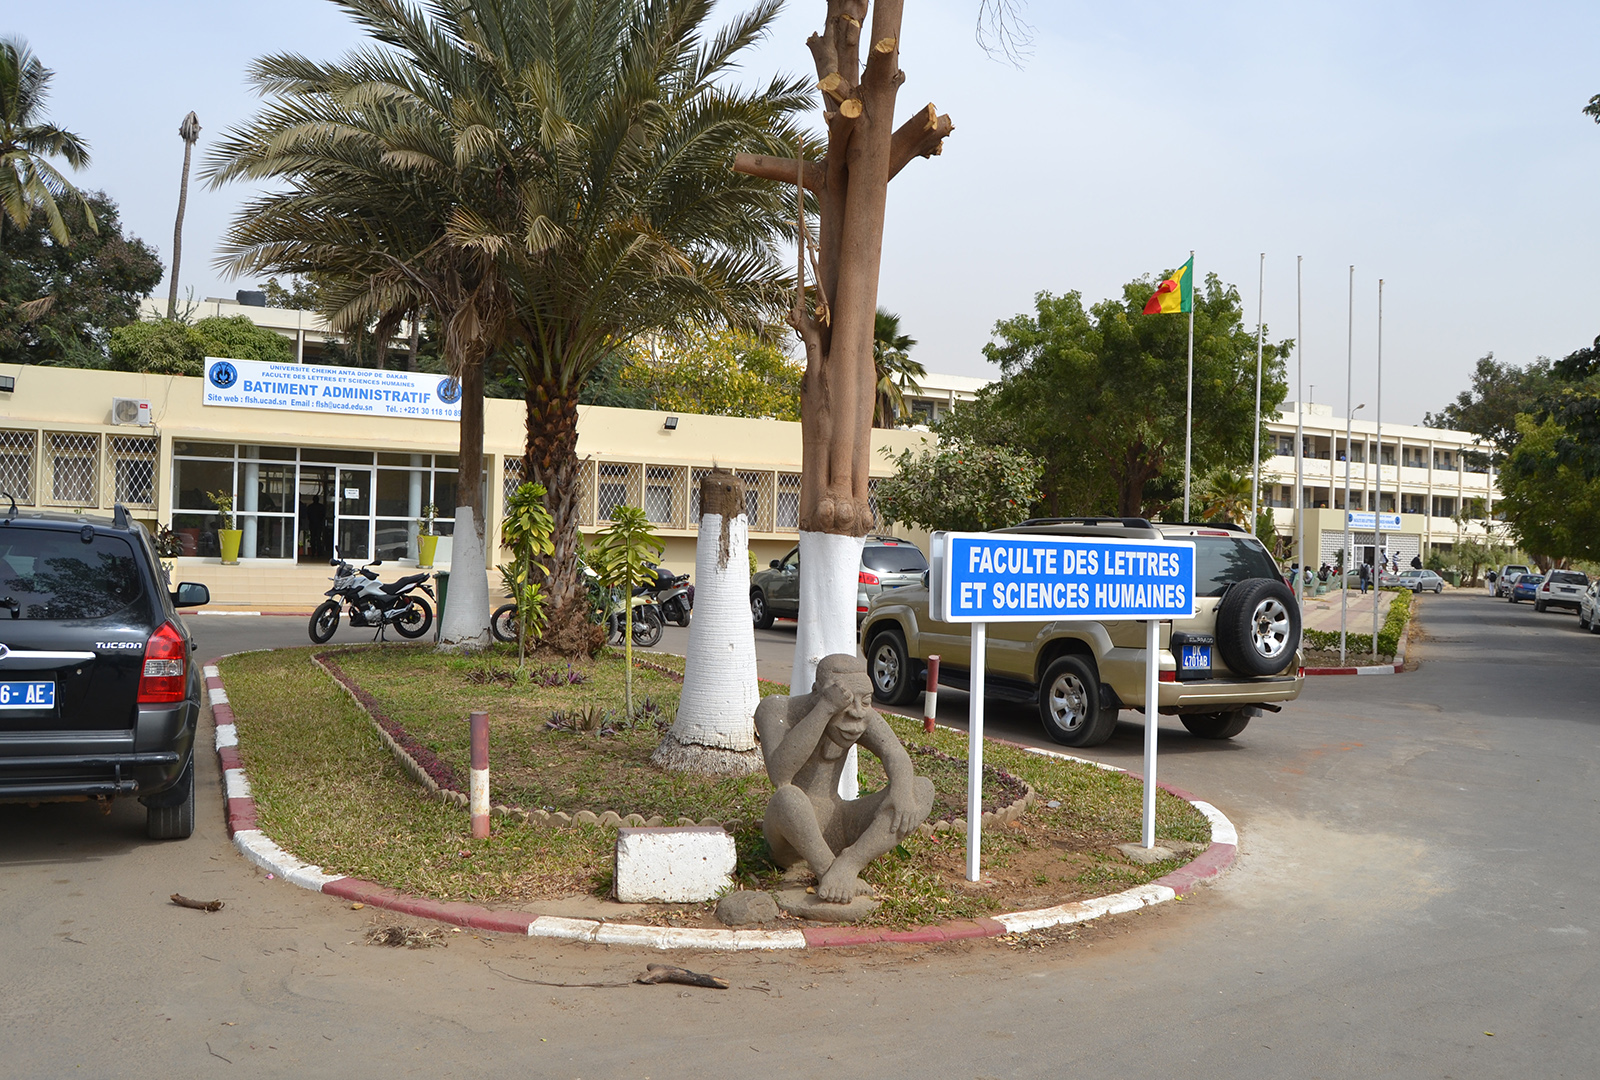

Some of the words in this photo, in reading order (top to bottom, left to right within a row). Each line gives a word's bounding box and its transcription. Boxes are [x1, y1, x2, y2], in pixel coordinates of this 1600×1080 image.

[270, 365, 309, 373] UNIVERSITE
[207, 393, 222, 401] Site
[291, 399, 310, 407] Email
[244, 380, 318, 396] BATIMENT
[322, 386, 431, 404] ADMINISTRATIF
[969, 546, 1057, 575] FACULTE
[1063, 549, 1099, 576] DES
[1104, 550, 1180, 577] LETTRES
[960, 582, 986, 609] ET
[992, 582, 1090, 609] SCIENCES
[1094, 583, 1186, 609] HUMAINES
[1192, 646, 1202, 656] DK
[26, 685, 46, 704] AE
